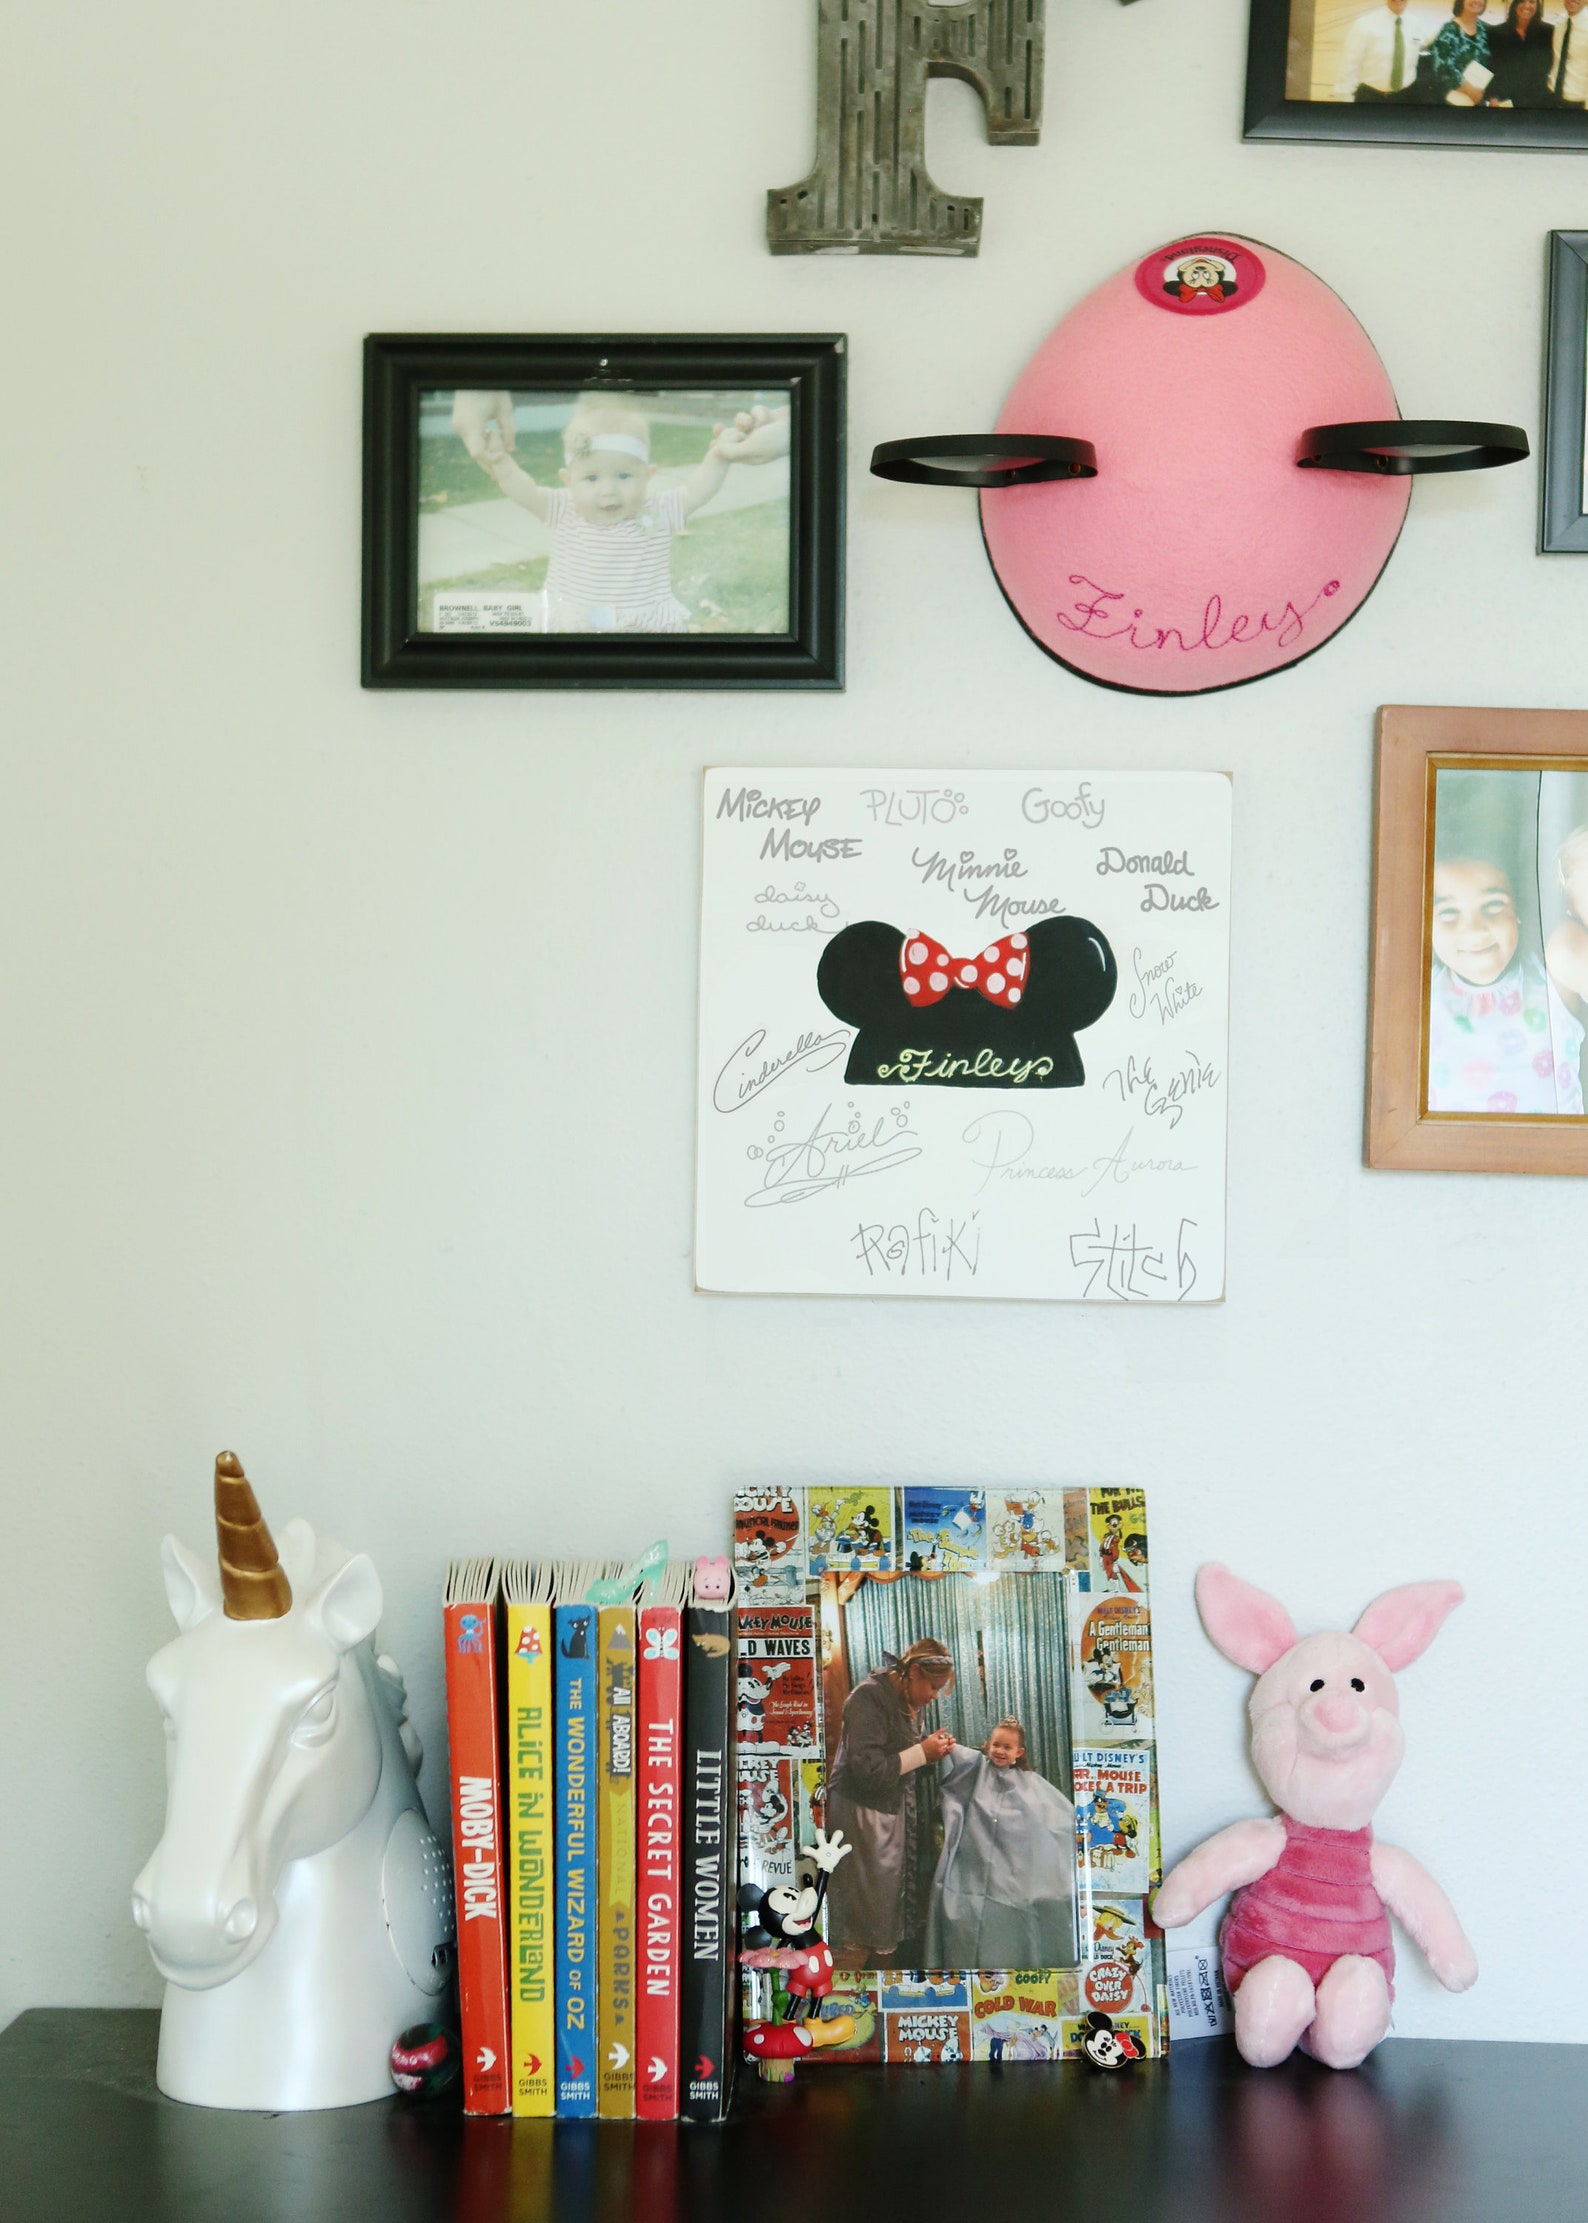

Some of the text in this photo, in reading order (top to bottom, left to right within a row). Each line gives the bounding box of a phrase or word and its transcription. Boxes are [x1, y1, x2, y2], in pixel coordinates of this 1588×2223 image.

[1056, 574, 1341, 651] Finley
[860, 789, 966, 826] PLUTO
[1021, 782, 1105, 829] Goofy
[911, 847, 1029, 892] Minnie
[1096, 847, 1196, 876] Donald
[754, 881, 841, 918] daisy
[1140, 883, 1220, 912] Duck
[963, 884, 1067, 930] Mouse
[746, 914, 846, 934] duck
[1129, 946, 1178, 1019] Snow
[1149, 976, 1204, 1026] White
[750, 1103, 921, 1203] Ariel
[962, 1110, 1198, 1198] Princess Aurora
[1090, 1501, 1110, 1515] THE
[770, 1613, 813, 1630] MOUSE
[1088, 1620, 1097, 1637] A
[764, 1639, 811, 1656] WAVES
[1096, 1636, 1151, 1652] Gentleman
[1097, 1752, 1145, 1764] DISNEY'S
[1097, 1769, 1142, 1782] MOUSE
[1105, 1781, 1115, 1793] A
[1117, 1782, 1148, 1795] TRIP
[459, 1775, 498, 1921] MOBY-DICK
[566, 1677, 586, 2030] THE WONDERFUL WIZARD OF OZ
[615, 1803, 629, 1896] NATIONAL
[694, 1749, 722, 1962] LITTLE WOMEN
[646, 1717, 674, 1997] THE SECRET GARDEN
[762, 1859, 793, 1875] REVUE
[612, 1926, 631, 2010] PARKS
[1089, 1966, 1128, 1982] CRAZY
[1094, 1980, 1122, 1992] OVER
[1091, 1989, 1129, 2003] DAISY
[974, 1995, 1057, 2019] COLD WAR
[897, 2014, 959, 2028] MICKEY
[898, 2027, 959, 2042] MOUSE
[518, 2079, 548, 2087] GIBBS
[560, 2081, 590, 2091] GIBBS
[603, 2073, 634, 2082] GIBBS
[689, 2081, 720, 2091] GIBBS
[518, 2087, 548, 2096] SMITH
[603, 2082, 635, 2091] SMITH
[560, 2091, 590, 2100] SMITH
[689, 2091, 720, 2100] SMITH
